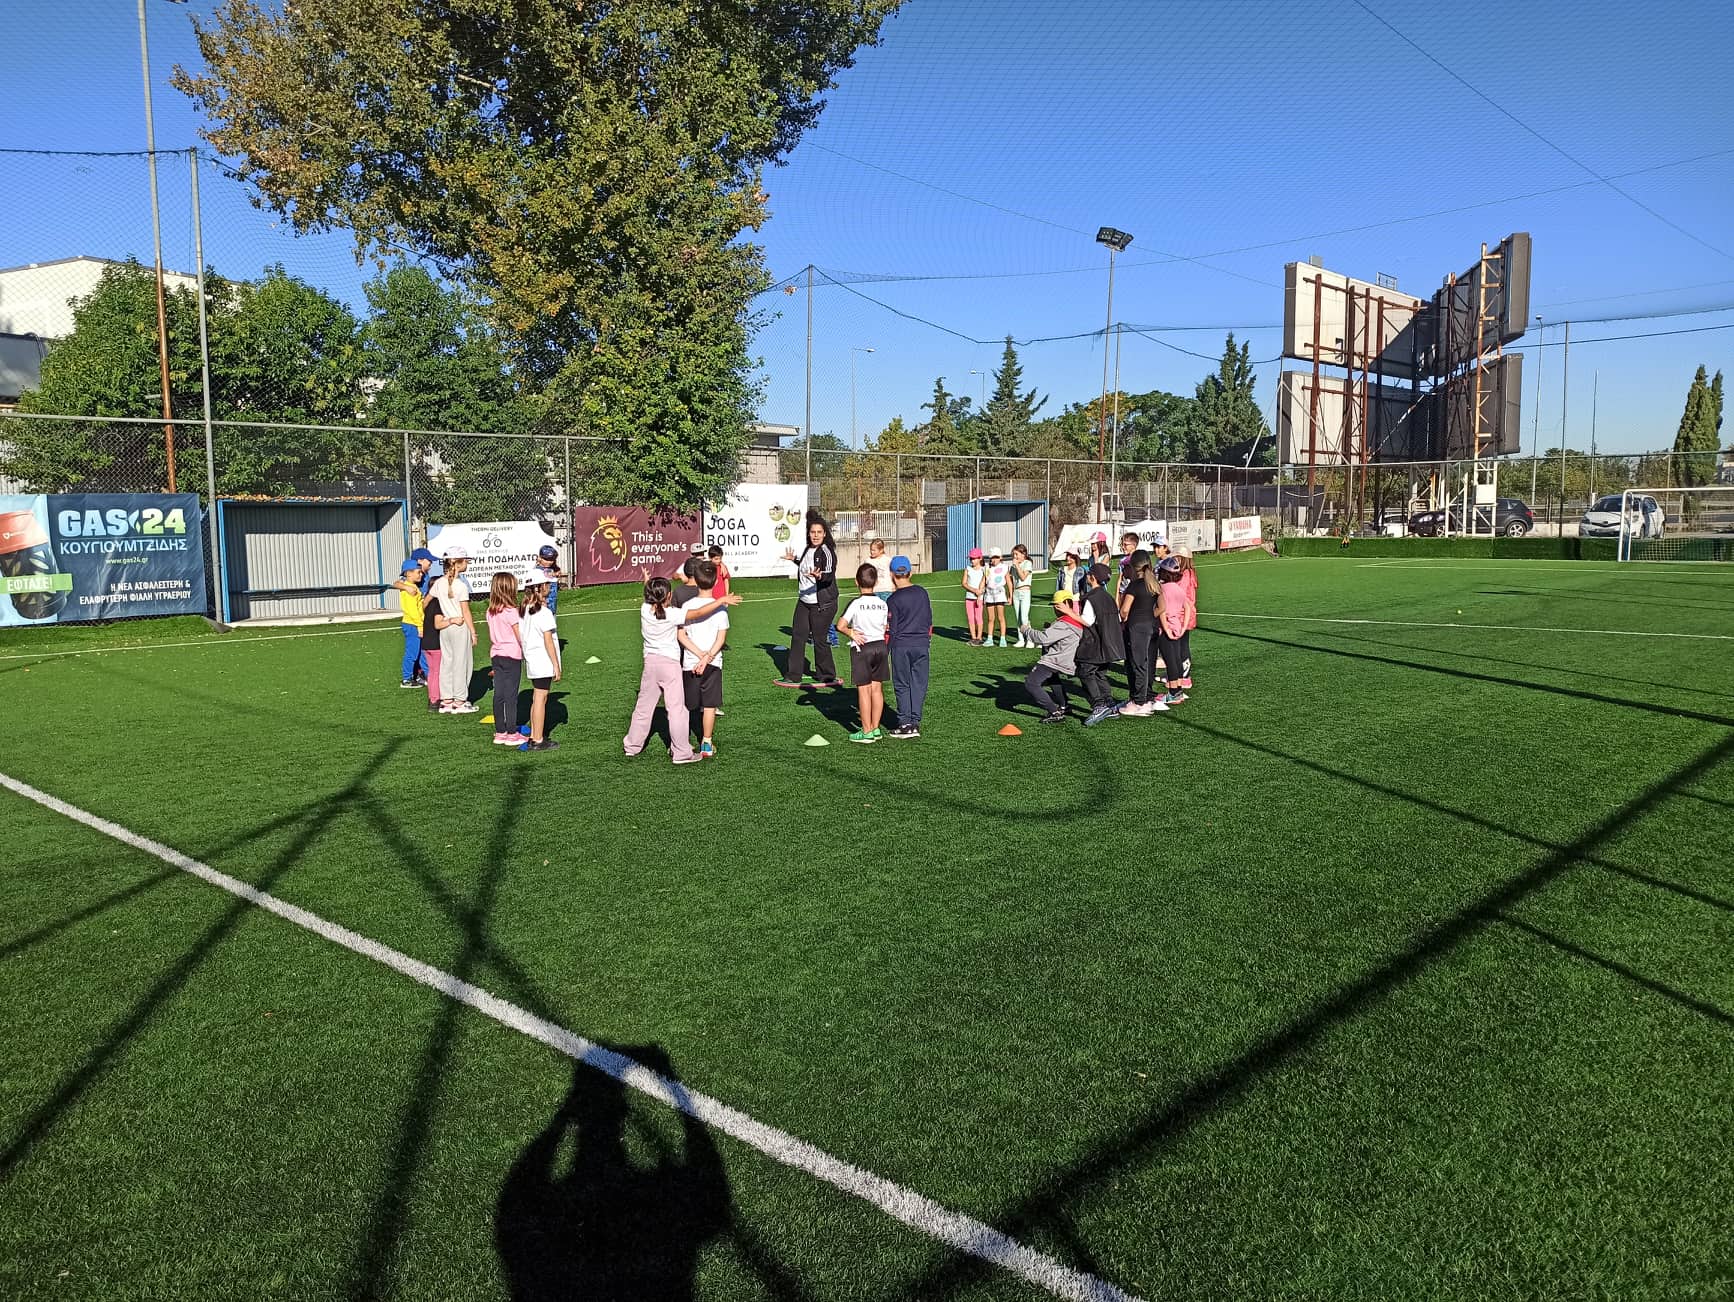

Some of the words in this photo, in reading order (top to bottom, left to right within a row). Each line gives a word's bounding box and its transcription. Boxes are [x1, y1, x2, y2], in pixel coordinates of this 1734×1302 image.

[58, 509, 129, 537] GAS
[142, 508, 187, 535] 24
[706, 517, 746, 530] JOGA
[632, 531, 654, 542] This
[655, 530, 663, 541] is
[707, 534, 760, 546] BONITO
[60, 539, 188, 555] ΚΟΥΓΙΟΥΜΤΖΙΔΗΣ
[632, 542, 687, 554] everyone's
[106, 557, 148, 565] www.gas24.gr
[631, 555, 664, 567] game.
[118, 582, 133, 591] ΝΕΑ
[185, 580, 191, 588] &
[129, 592, 153, 602] ΦΙΑΛΗ
